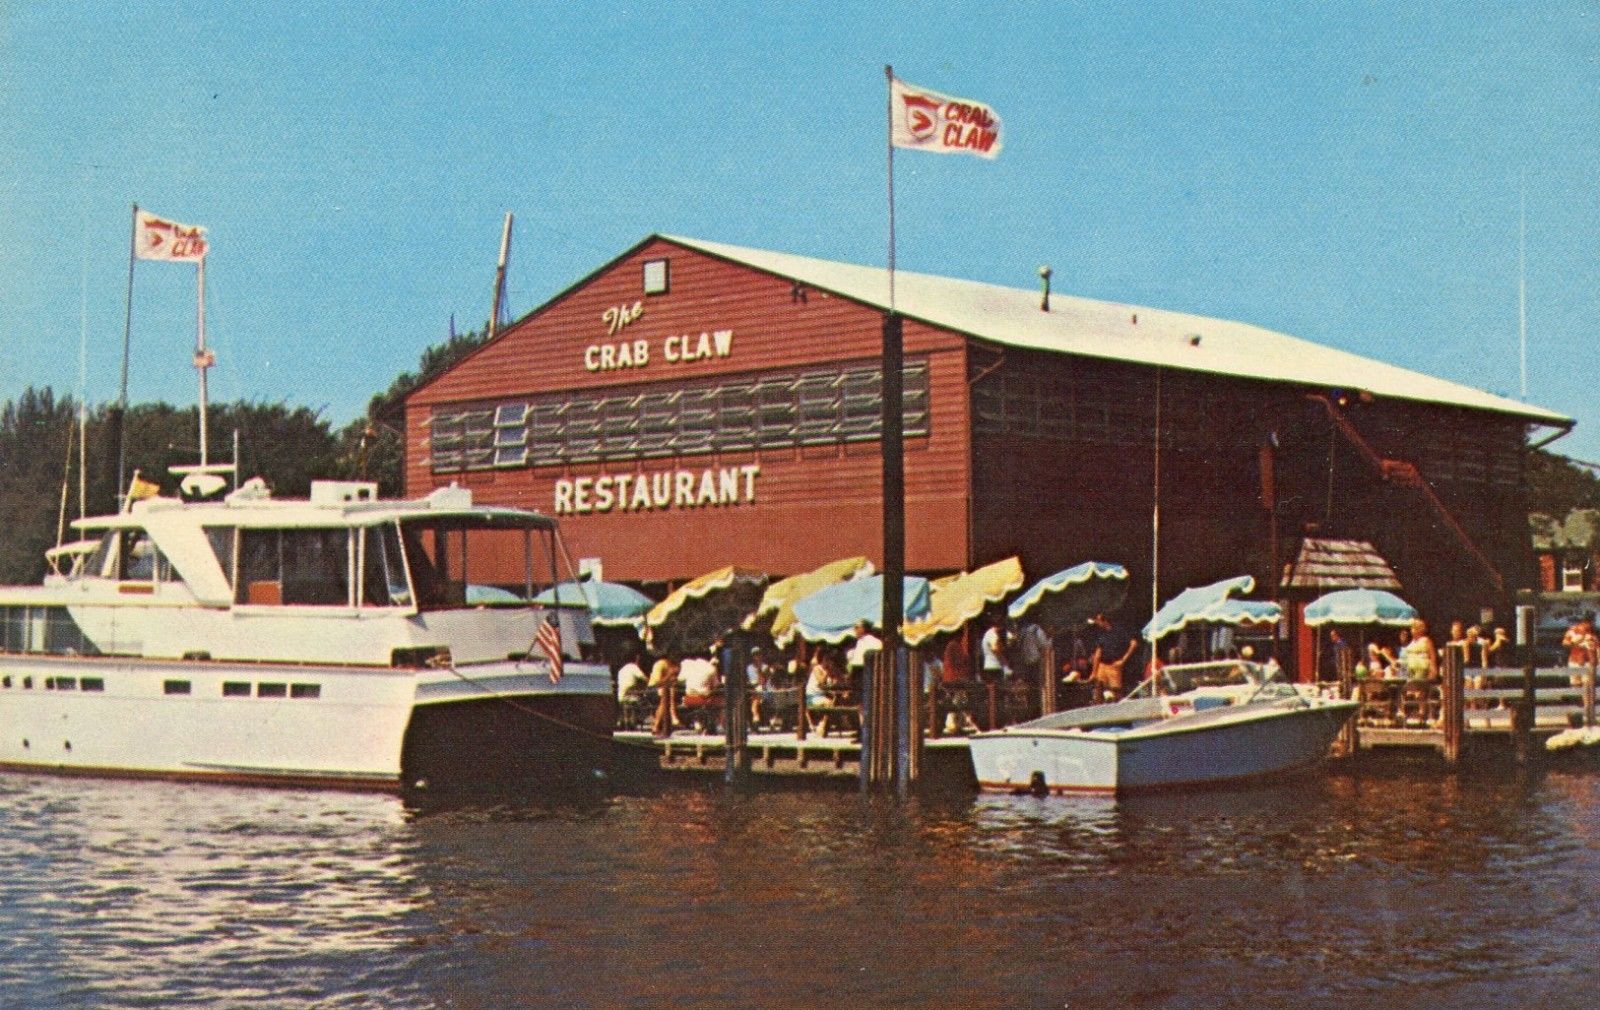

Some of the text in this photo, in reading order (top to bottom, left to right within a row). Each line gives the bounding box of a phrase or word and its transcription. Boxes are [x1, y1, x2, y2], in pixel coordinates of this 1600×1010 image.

[943, 122, 998, 152] CLAW
[602, 301, 643, 335] The
[584, 329, 733, 371] CRAB CLAW
[555, 465, 760, 513] RESTAURANT
